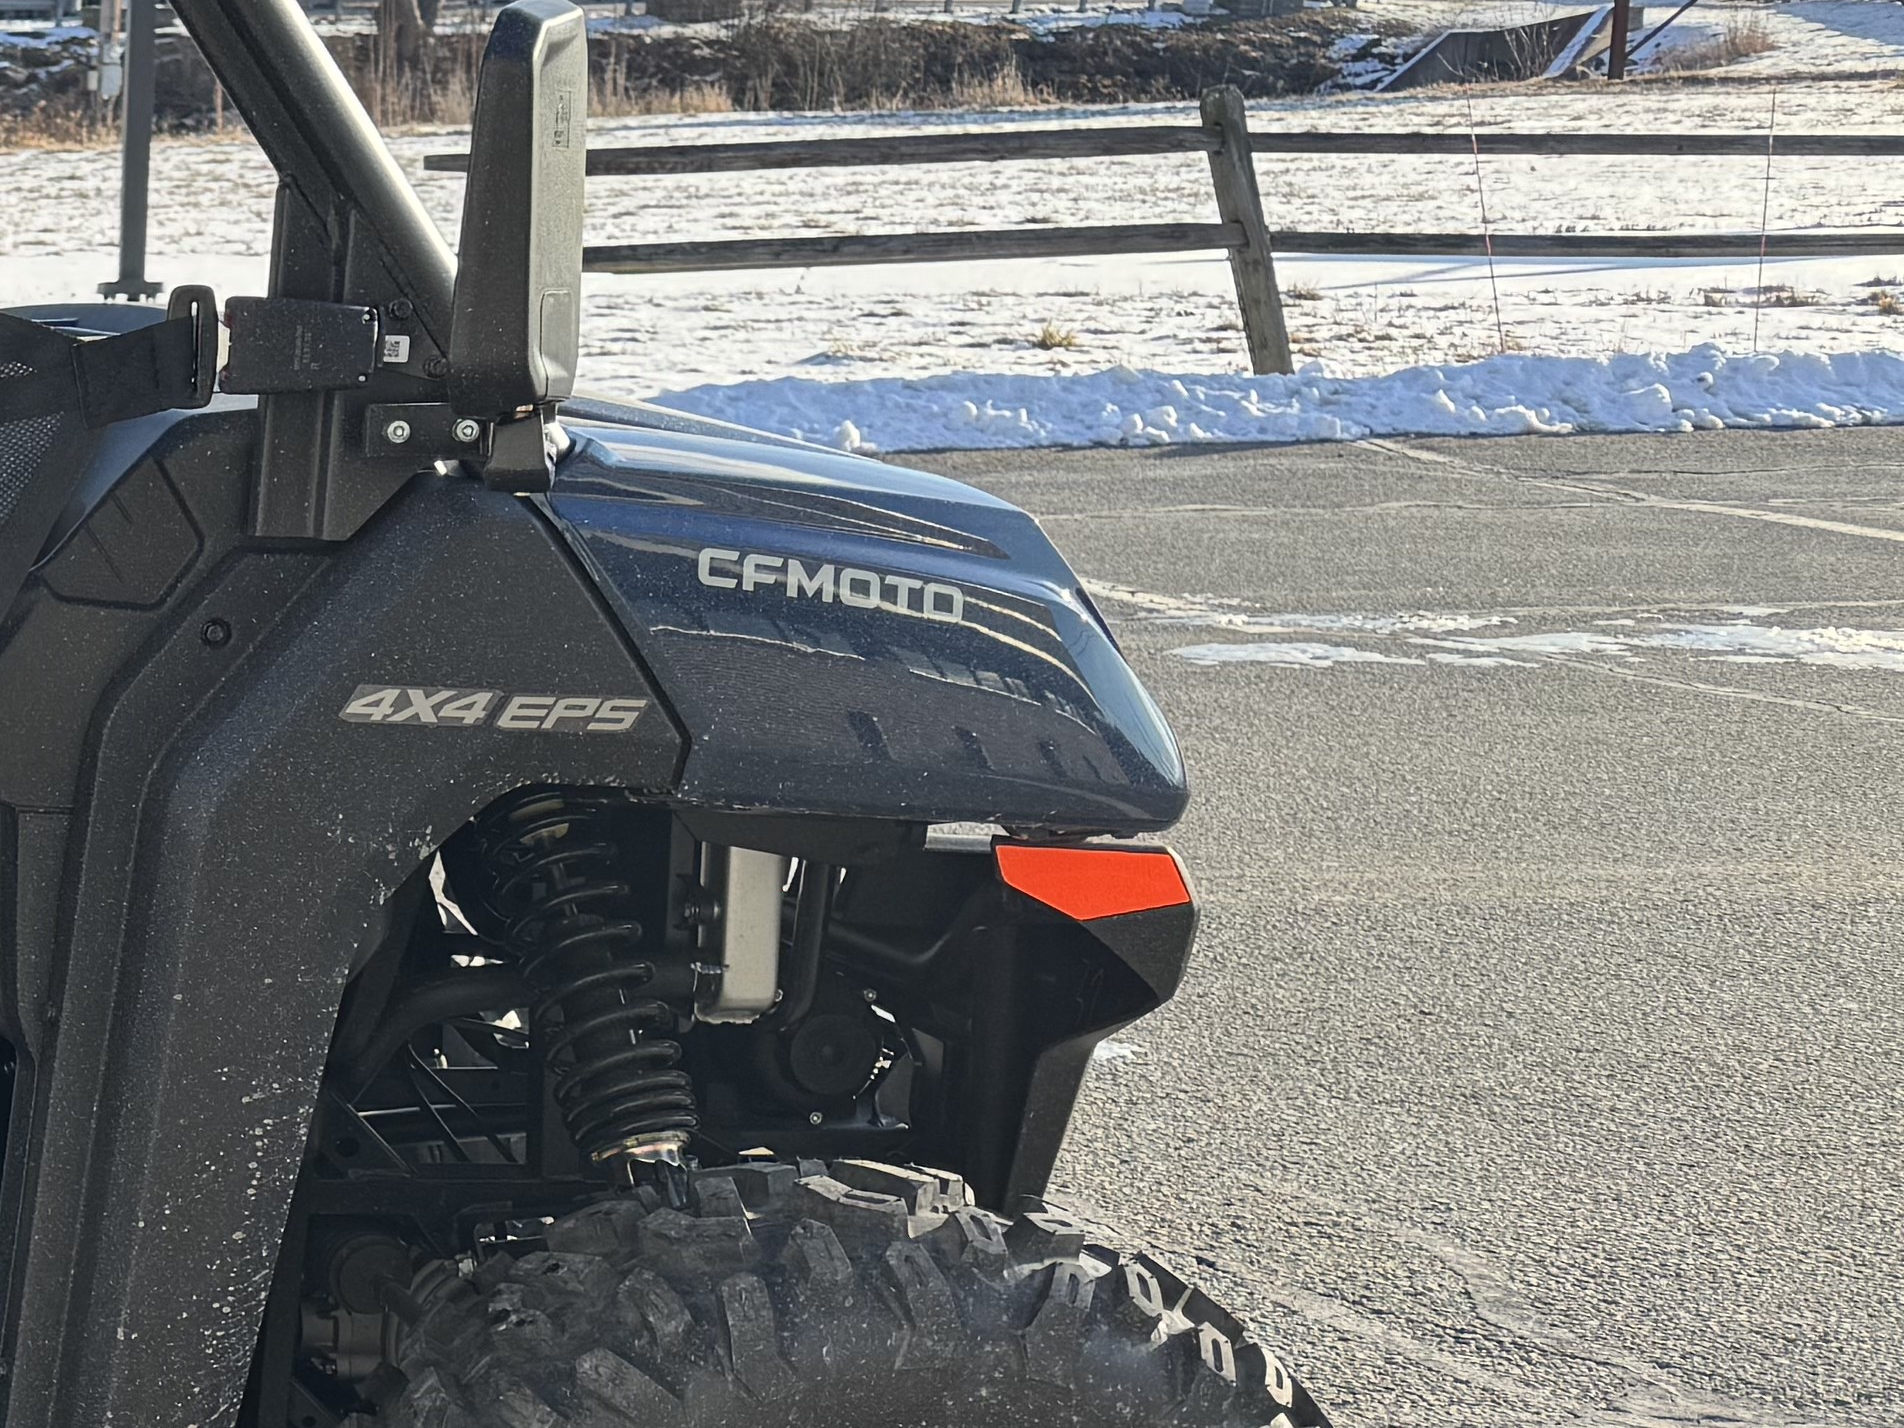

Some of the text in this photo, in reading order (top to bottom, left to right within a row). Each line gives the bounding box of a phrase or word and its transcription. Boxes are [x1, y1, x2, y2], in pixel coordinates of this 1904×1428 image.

[697, 547, 964, 623] CFMOTO
[345, 688, 647, 730] 4X4 EPS
